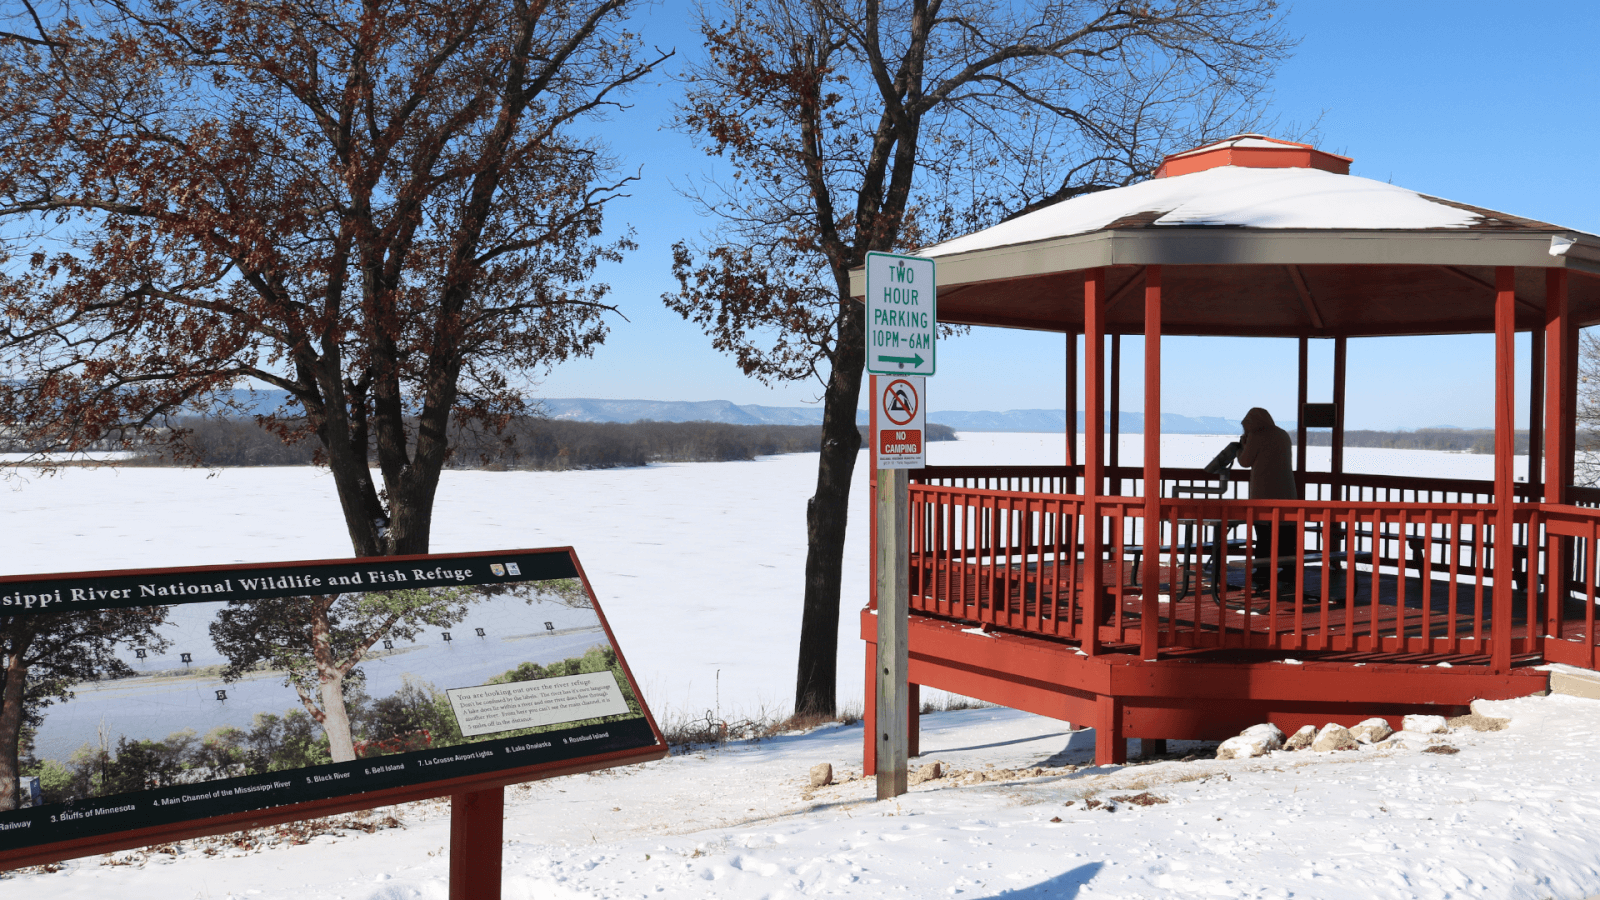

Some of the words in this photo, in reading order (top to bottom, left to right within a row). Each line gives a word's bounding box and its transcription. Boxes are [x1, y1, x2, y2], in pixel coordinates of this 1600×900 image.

[889, 266, 914, 284] TWO
[884, 287, 918, 306] HOUR
[874, 309, 928, 328] PARKING
[896, 431, 906, 440] NO
[885, 444, 917, 453] CAMPING
[2, 590, 62, 608] sippi
[70, 587, 132, 602] River
[138, 579, 234, 598] National
[238, 574, 322, 591] Wildlife
[328, 571, 363, 586] and
[367, 568, 408, 584] Fish
[412, 566, 474, 582] Refuge
[569, 734, 592, 743] Rosebud
[592, 732, 610, 740] Island
[433, 756, 454, 764] Crosse
[455, 753, 476, 761] Airport
[476, 750, 494, 758] Lights
[372, 766, 385, 774] Bell
[386, 763, 404, 772] Island
[314, 774, 332, 782] Black
[334, 772, 350, 780] River
[161, 797, 180, 806] Main
[182, 792, 212, 802] Channel
[234, 782, 272, 795] Mississippi
[60, 811, 84, 821] Bluffs
[85, 809, 94, 818] of
[94, 804, 136, 816] Minnesota
[0, 820, 31, 830] Railway
